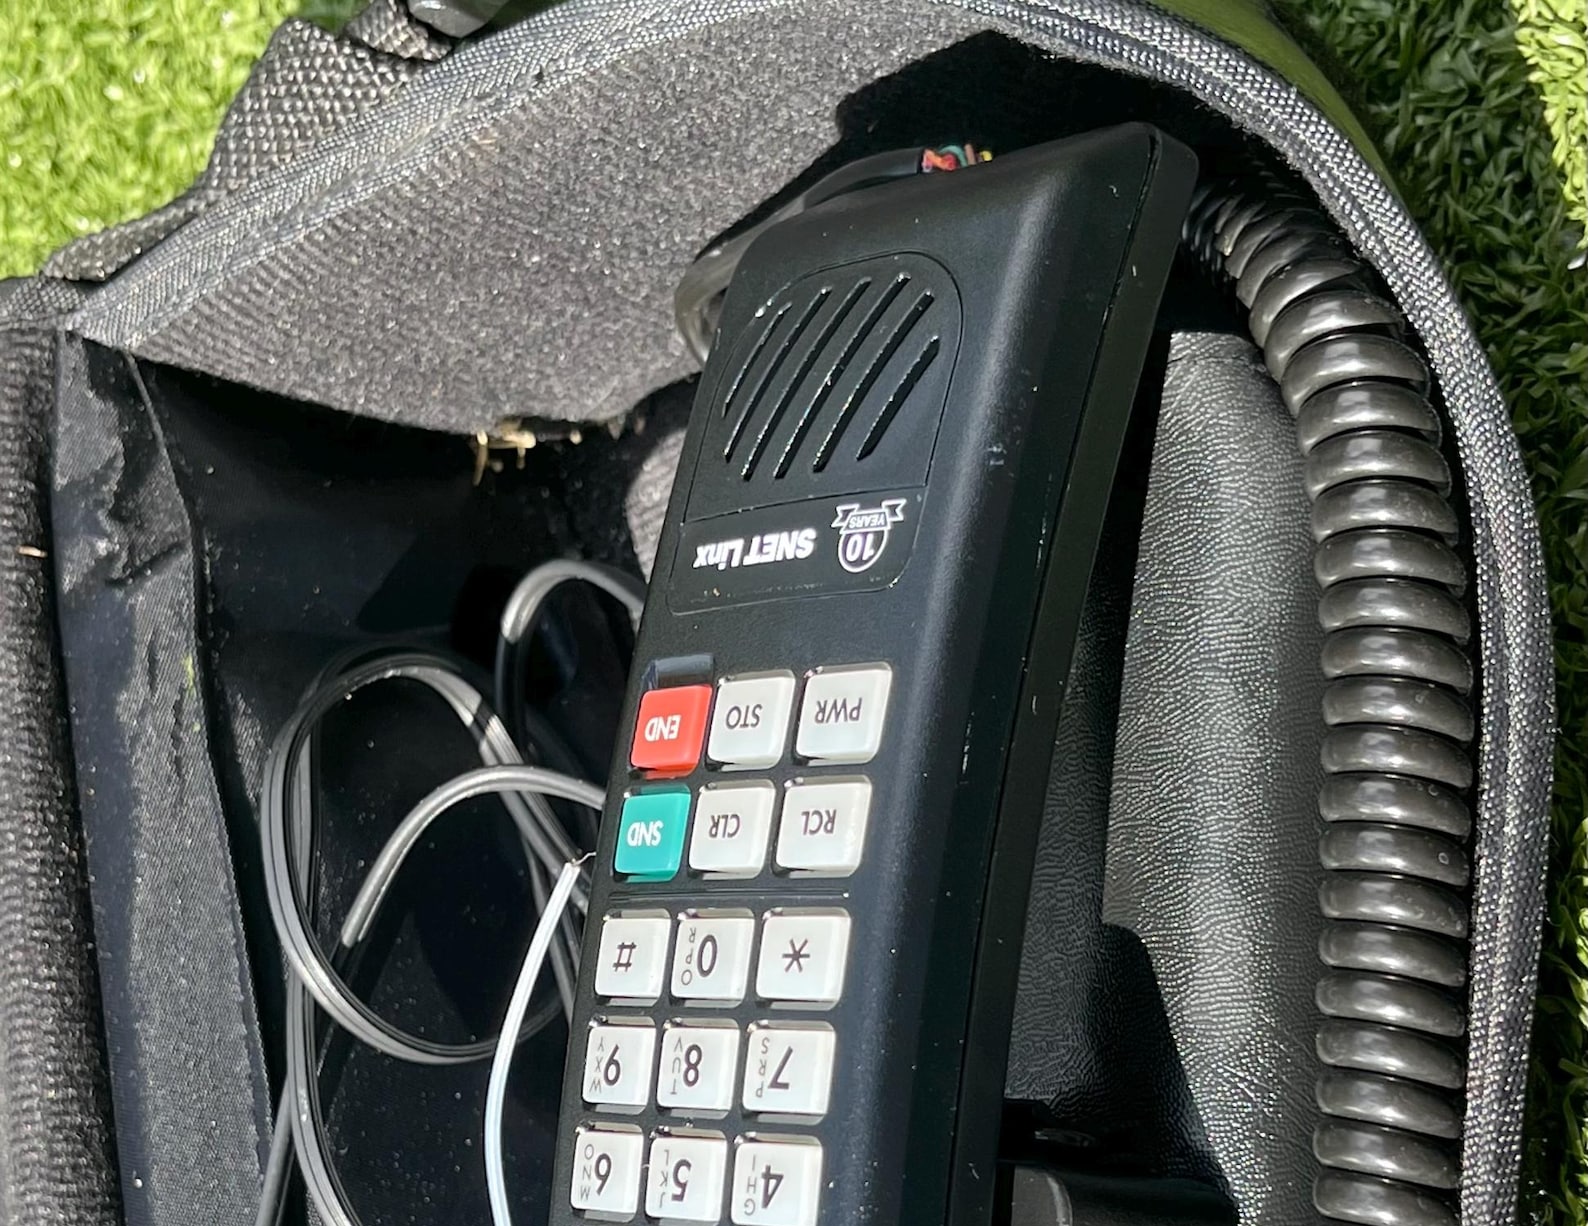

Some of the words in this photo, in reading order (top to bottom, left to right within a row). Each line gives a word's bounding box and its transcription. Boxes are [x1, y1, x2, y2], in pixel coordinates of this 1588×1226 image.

[847, 513, 885, 528] YEARS
[693, 541, 742, 568] Linx
[742, 527, 815, 566] SNET
[847, 532, 874, 561] 10
[725, 703, 761, 727] STO
[814, 697, 861, 723] PWR
[644, 714, 679, 740] END
[626, 819, 662, 845] SND
[708, 813, 739, 837] CLR
[801, 809, 836, 833] RCL
[611, 941, 635, 972] #
[696, 933, 716, 977] 0
[602, 1044, 620, 1085] 9
[683, 1044, 701, 1086] 8
[767, 1045, 792, 1089] 7
[594, 1152, 611, 1193] 6
[671, 1158, 691, 1200] 5
[760, 1164, 783, 1207] 4
